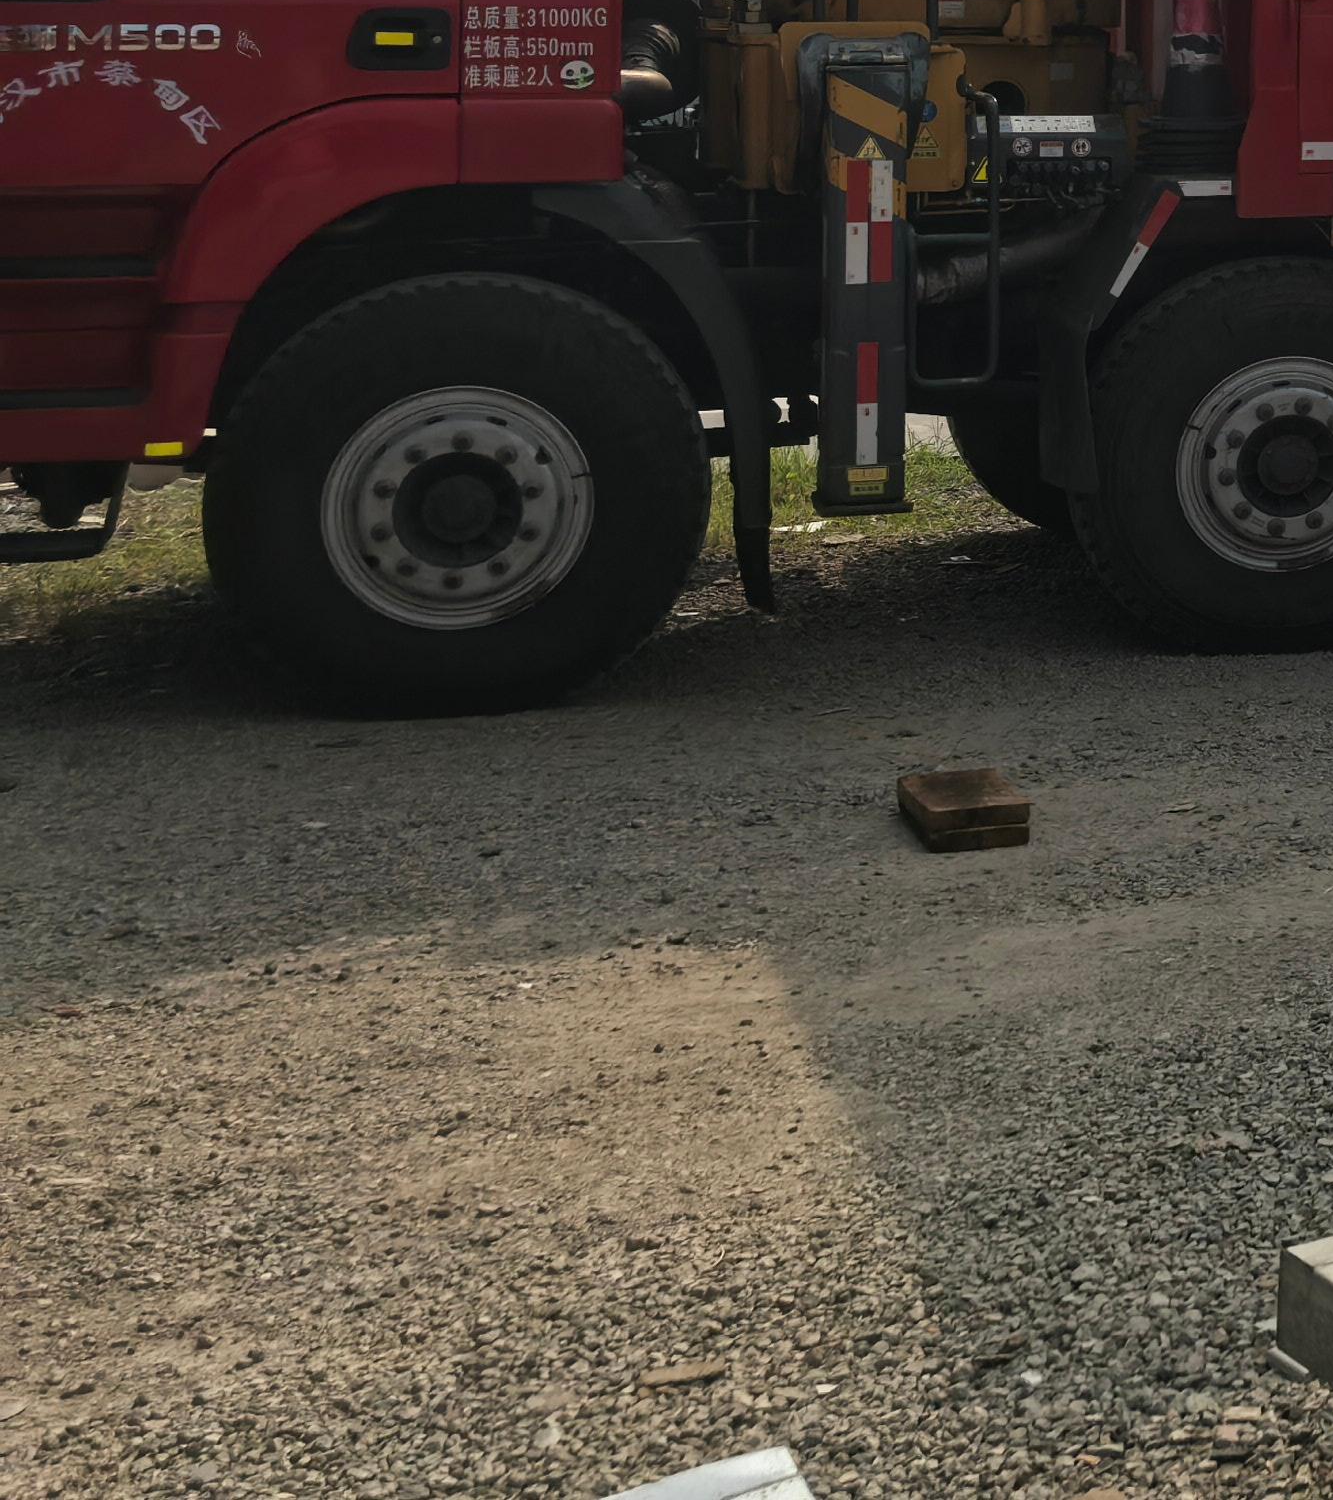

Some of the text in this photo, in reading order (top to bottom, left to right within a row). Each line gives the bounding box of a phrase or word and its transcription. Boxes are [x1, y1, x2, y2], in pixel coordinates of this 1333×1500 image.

[464, 6, 608, 29] 总质量:31000KG
[464, 35, 594, 59] 栏板高:550mm
[0, 59, 221, 145] 汉市蔡甸区
